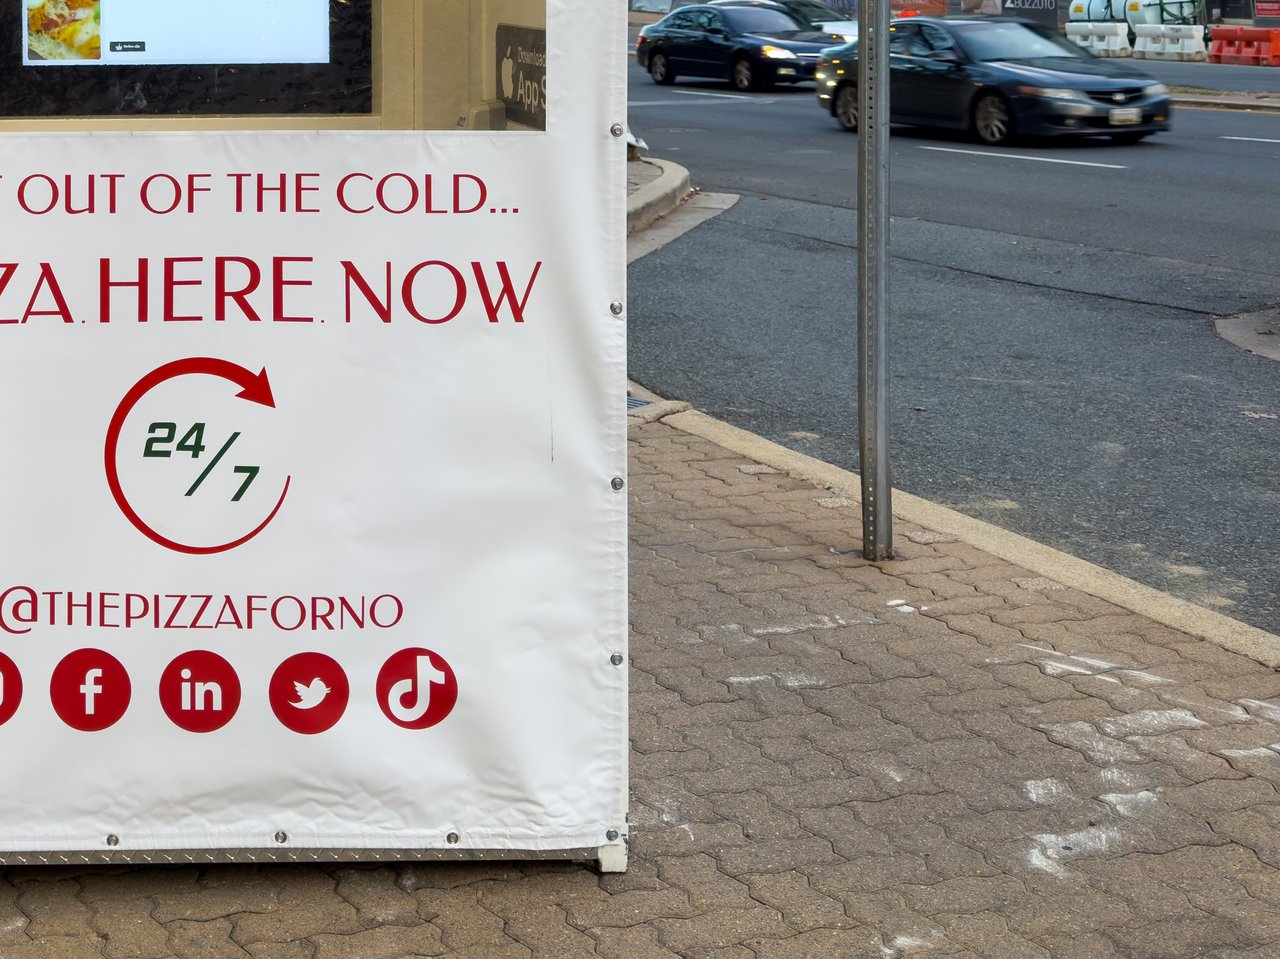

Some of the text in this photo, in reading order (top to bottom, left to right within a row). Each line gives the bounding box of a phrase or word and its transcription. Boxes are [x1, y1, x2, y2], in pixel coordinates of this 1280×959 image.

[517, 70, 539, 114] App
[17, 173, 126, 215] OUT
[139, 173, 212, 214] OF
[226, 172, 321, 213] THE
[336, 172, 520, 214] COLD...
[339, 260, 542, 324] NOW
[143, 421, 260, 502] 24/7
